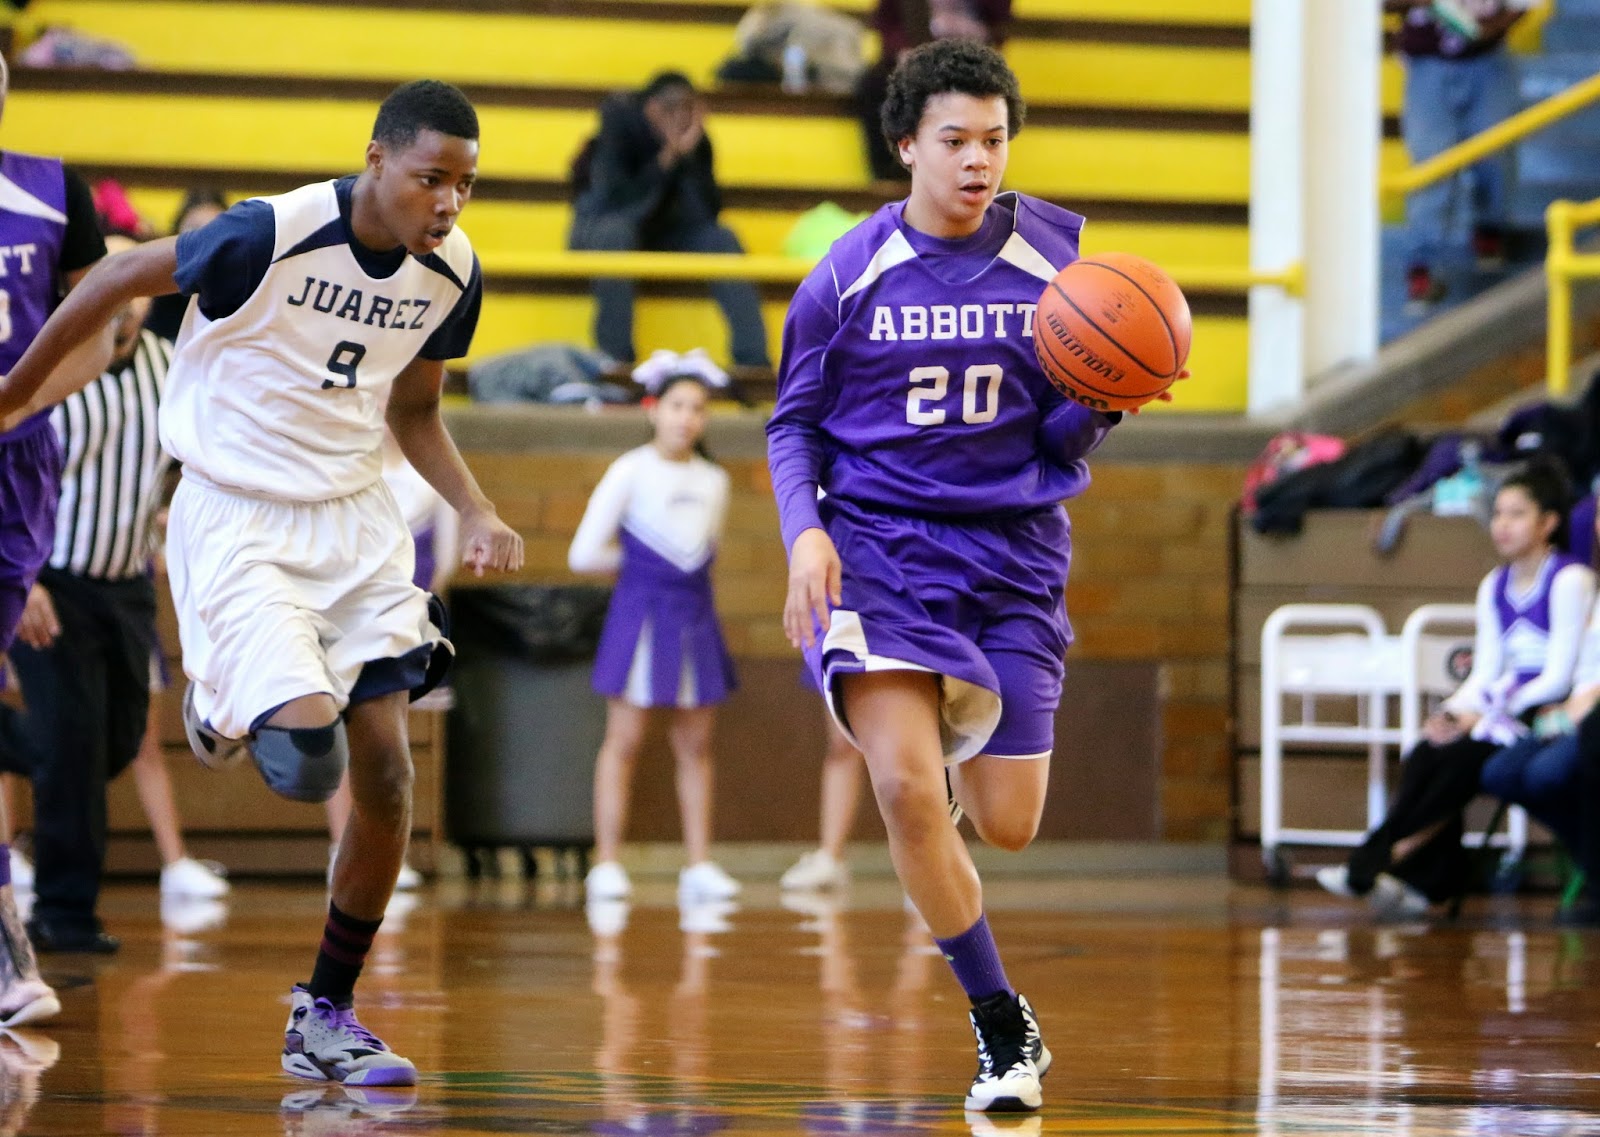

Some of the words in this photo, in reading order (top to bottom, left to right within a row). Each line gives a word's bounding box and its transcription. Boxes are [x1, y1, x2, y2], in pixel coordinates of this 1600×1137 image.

[287, 276, 431, 330] JUAREZ
[869, 303, 1037, 341] ABBOTT
[321, 340, 366, 389] 9
[1046, 312, 1126, 383] EVOLUTION
[906, 364, 1004, 426] 20
